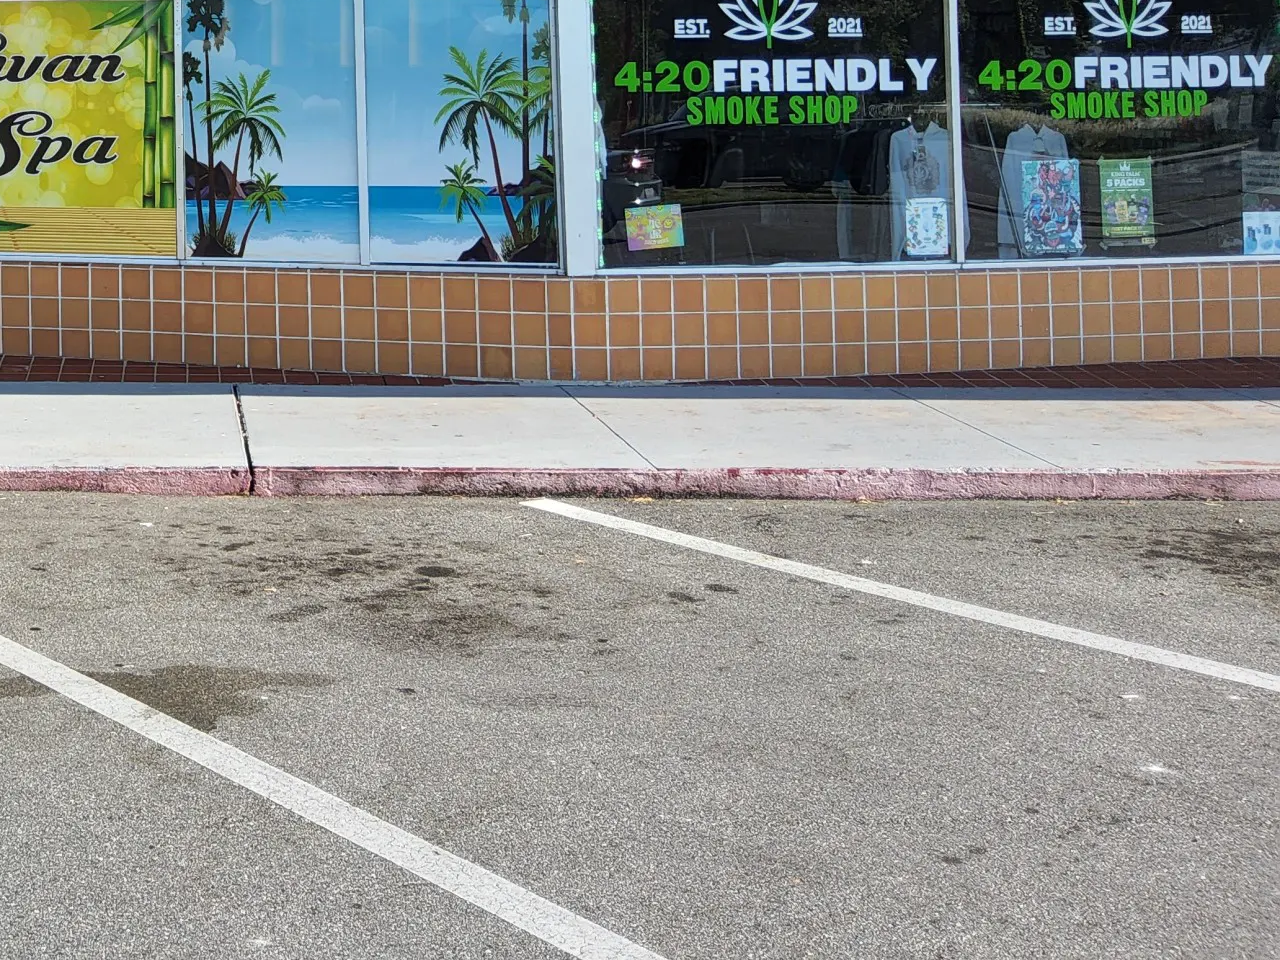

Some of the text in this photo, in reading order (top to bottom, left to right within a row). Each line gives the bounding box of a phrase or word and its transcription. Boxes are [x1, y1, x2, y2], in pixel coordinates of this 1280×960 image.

[674, 17, 862, 37] EST. 2021
[1044, 15, 1212, 35] EST. 2021
[686, 95, 858, 125] SMOKE SHOP
[1050, 88, 1208, 120] SMOKE SHOP
